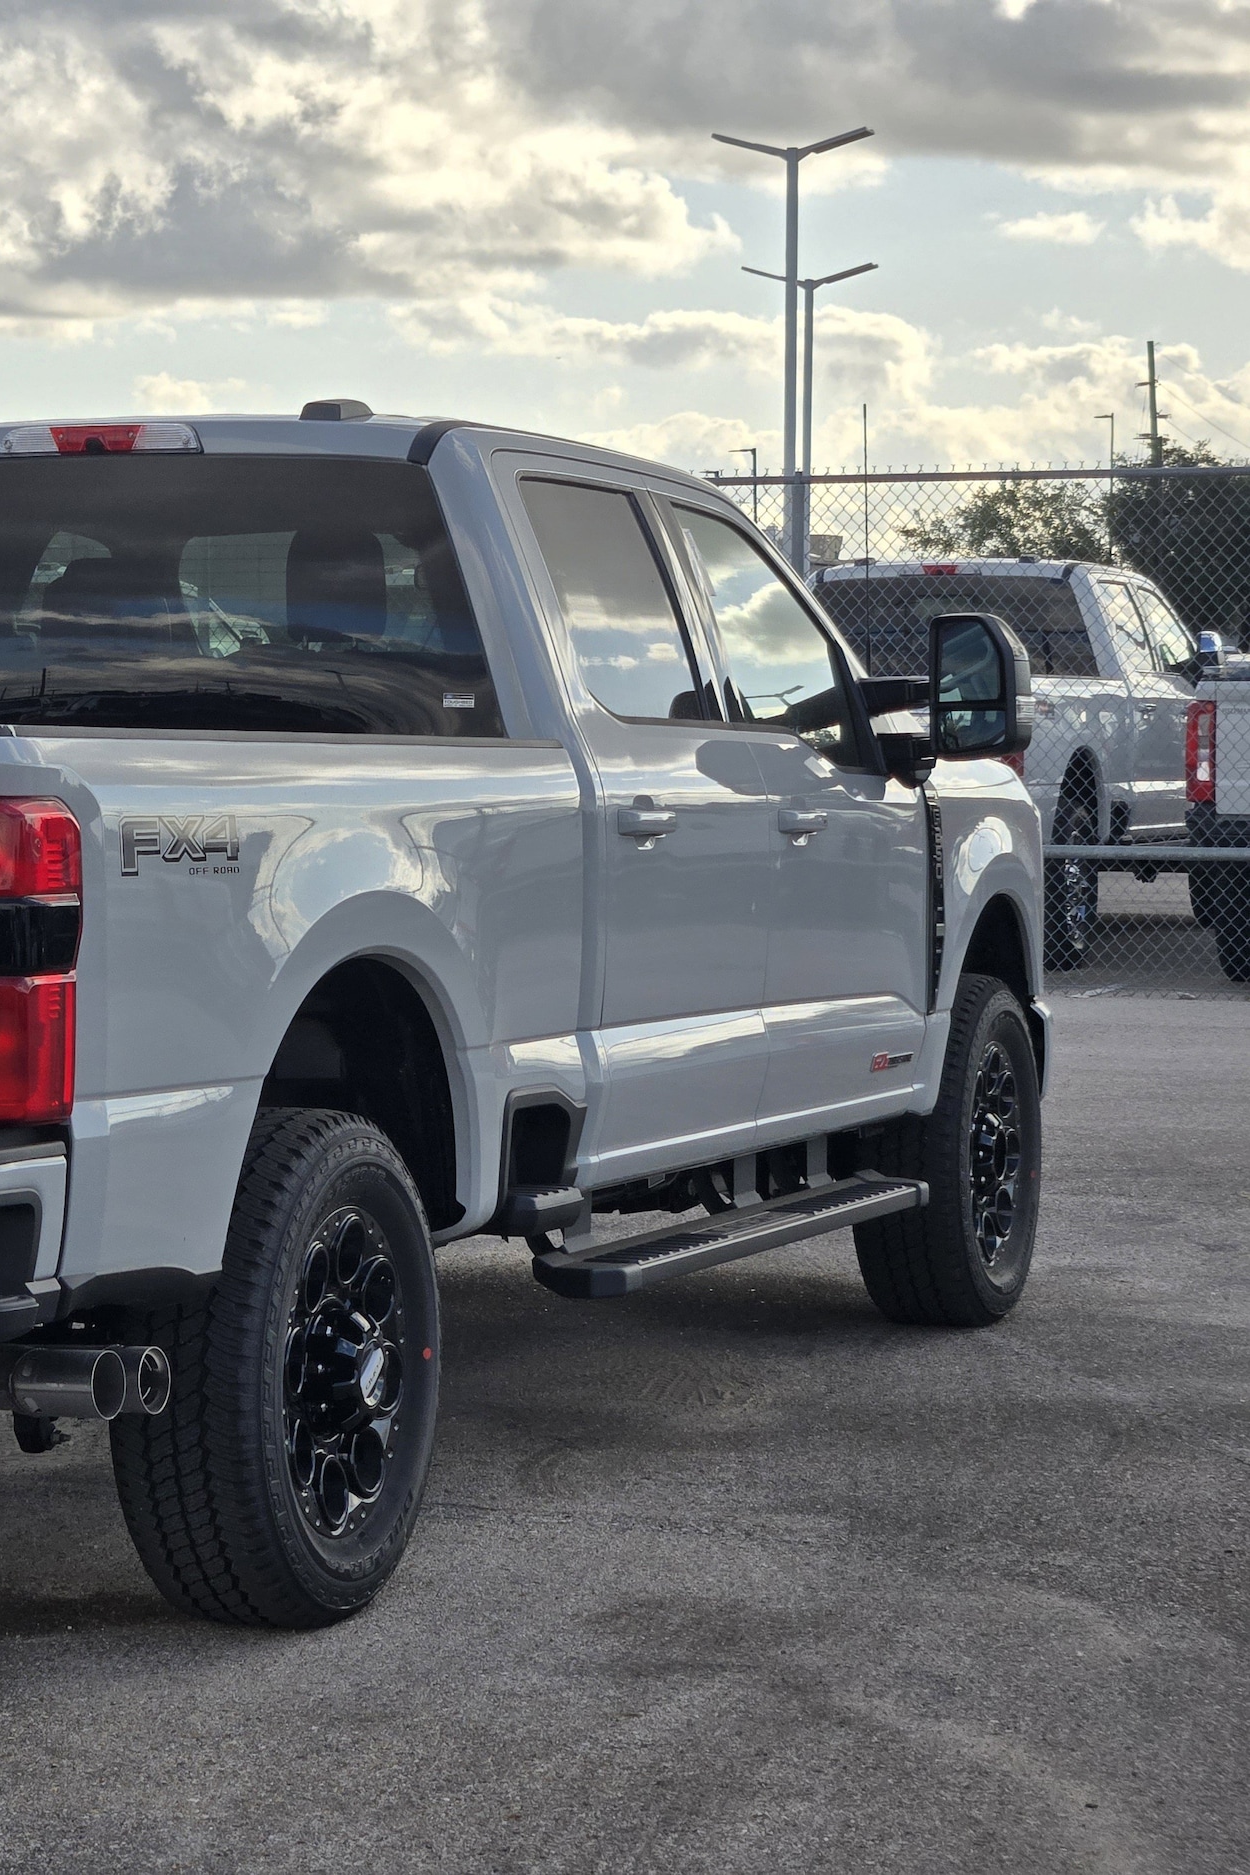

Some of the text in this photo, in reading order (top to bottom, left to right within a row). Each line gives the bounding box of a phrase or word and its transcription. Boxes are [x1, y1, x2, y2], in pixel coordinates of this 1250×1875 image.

[118, 814, 240, 878] FX4
[189, 866, 240, 875] OFF ROAD
